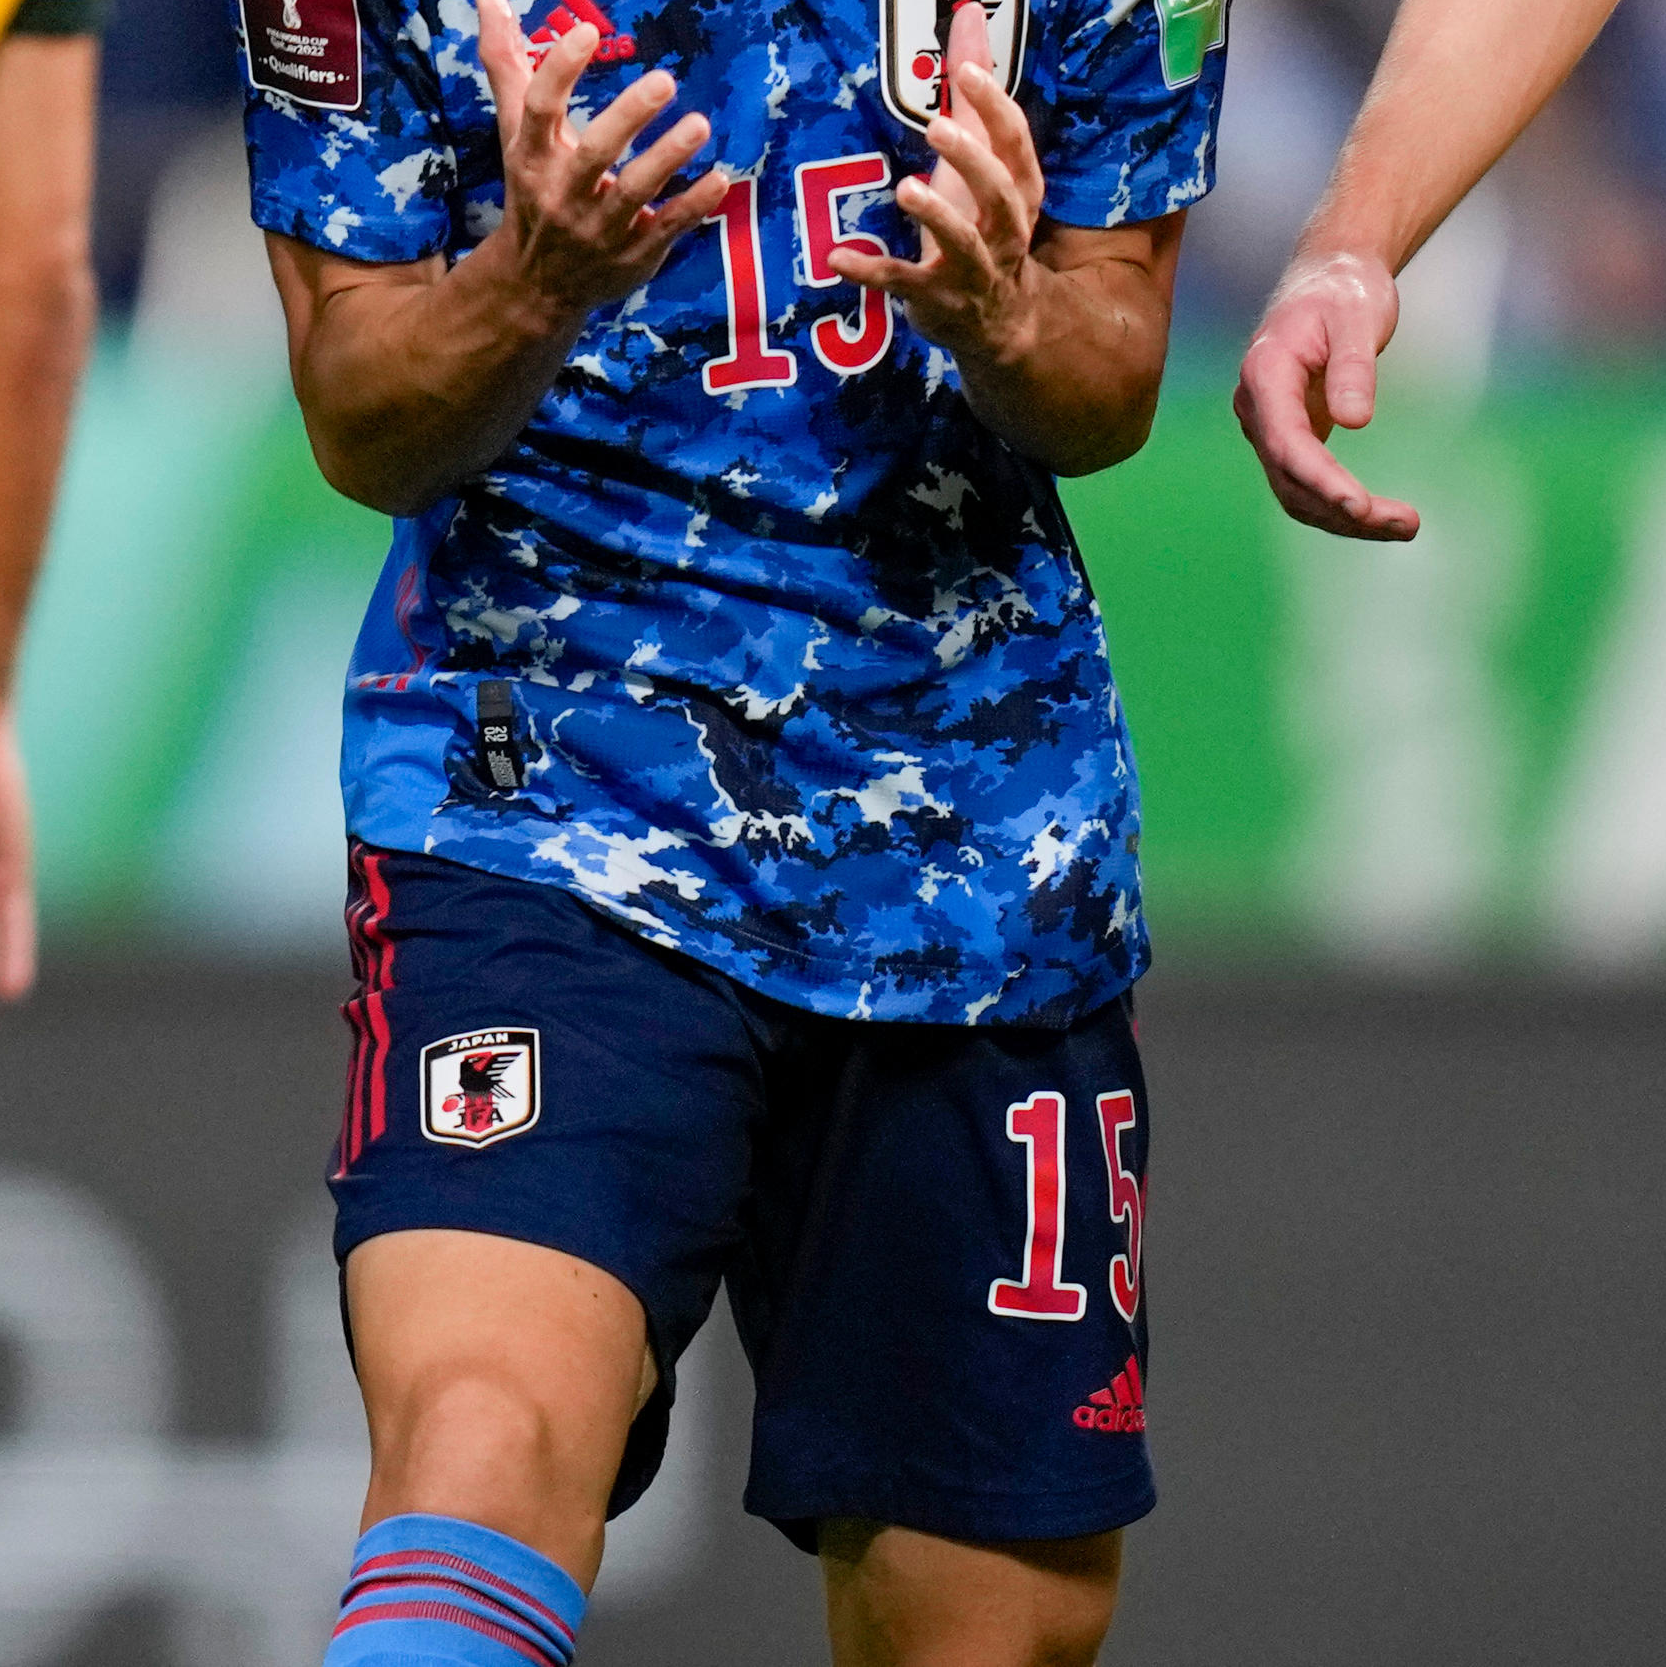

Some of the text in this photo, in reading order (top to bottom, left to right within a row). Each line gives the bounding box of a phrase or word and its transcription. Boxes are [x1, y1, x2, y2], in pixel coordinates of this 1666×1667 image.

[268, 54, 336, 84] Qualifiers
[701, 151, 894, 397] 15
[447, 1032, 509, 1052] JAPAN
[986, 1087, 1142, 1324] 15
